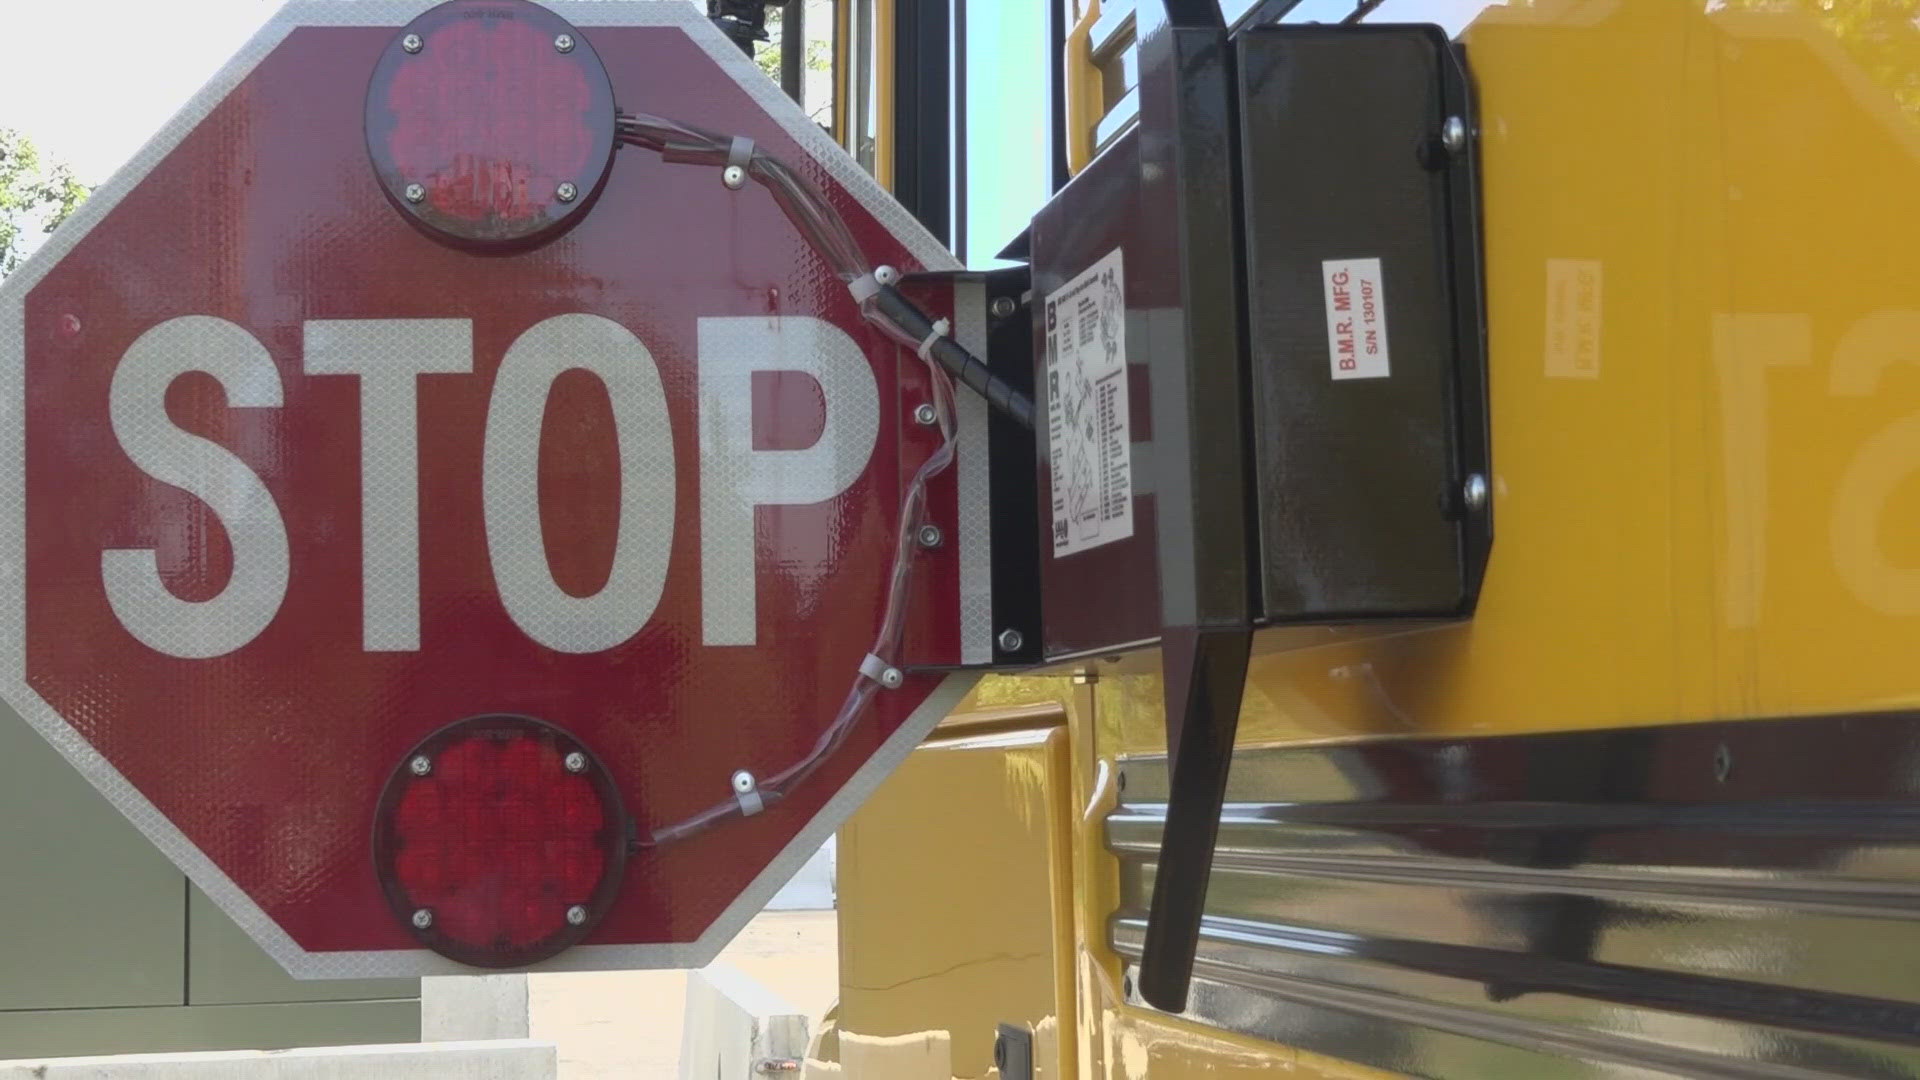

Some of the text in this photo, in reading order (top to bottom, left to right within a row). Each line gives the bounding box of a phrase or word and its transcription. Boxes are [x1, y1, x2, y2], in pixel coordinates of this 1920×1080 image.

[1332, 267, 1356, 371] B.M.R. MFG.
[1360, 279, 1378, 356] S/N 130107
[101, 313, 881, 659] STOP
